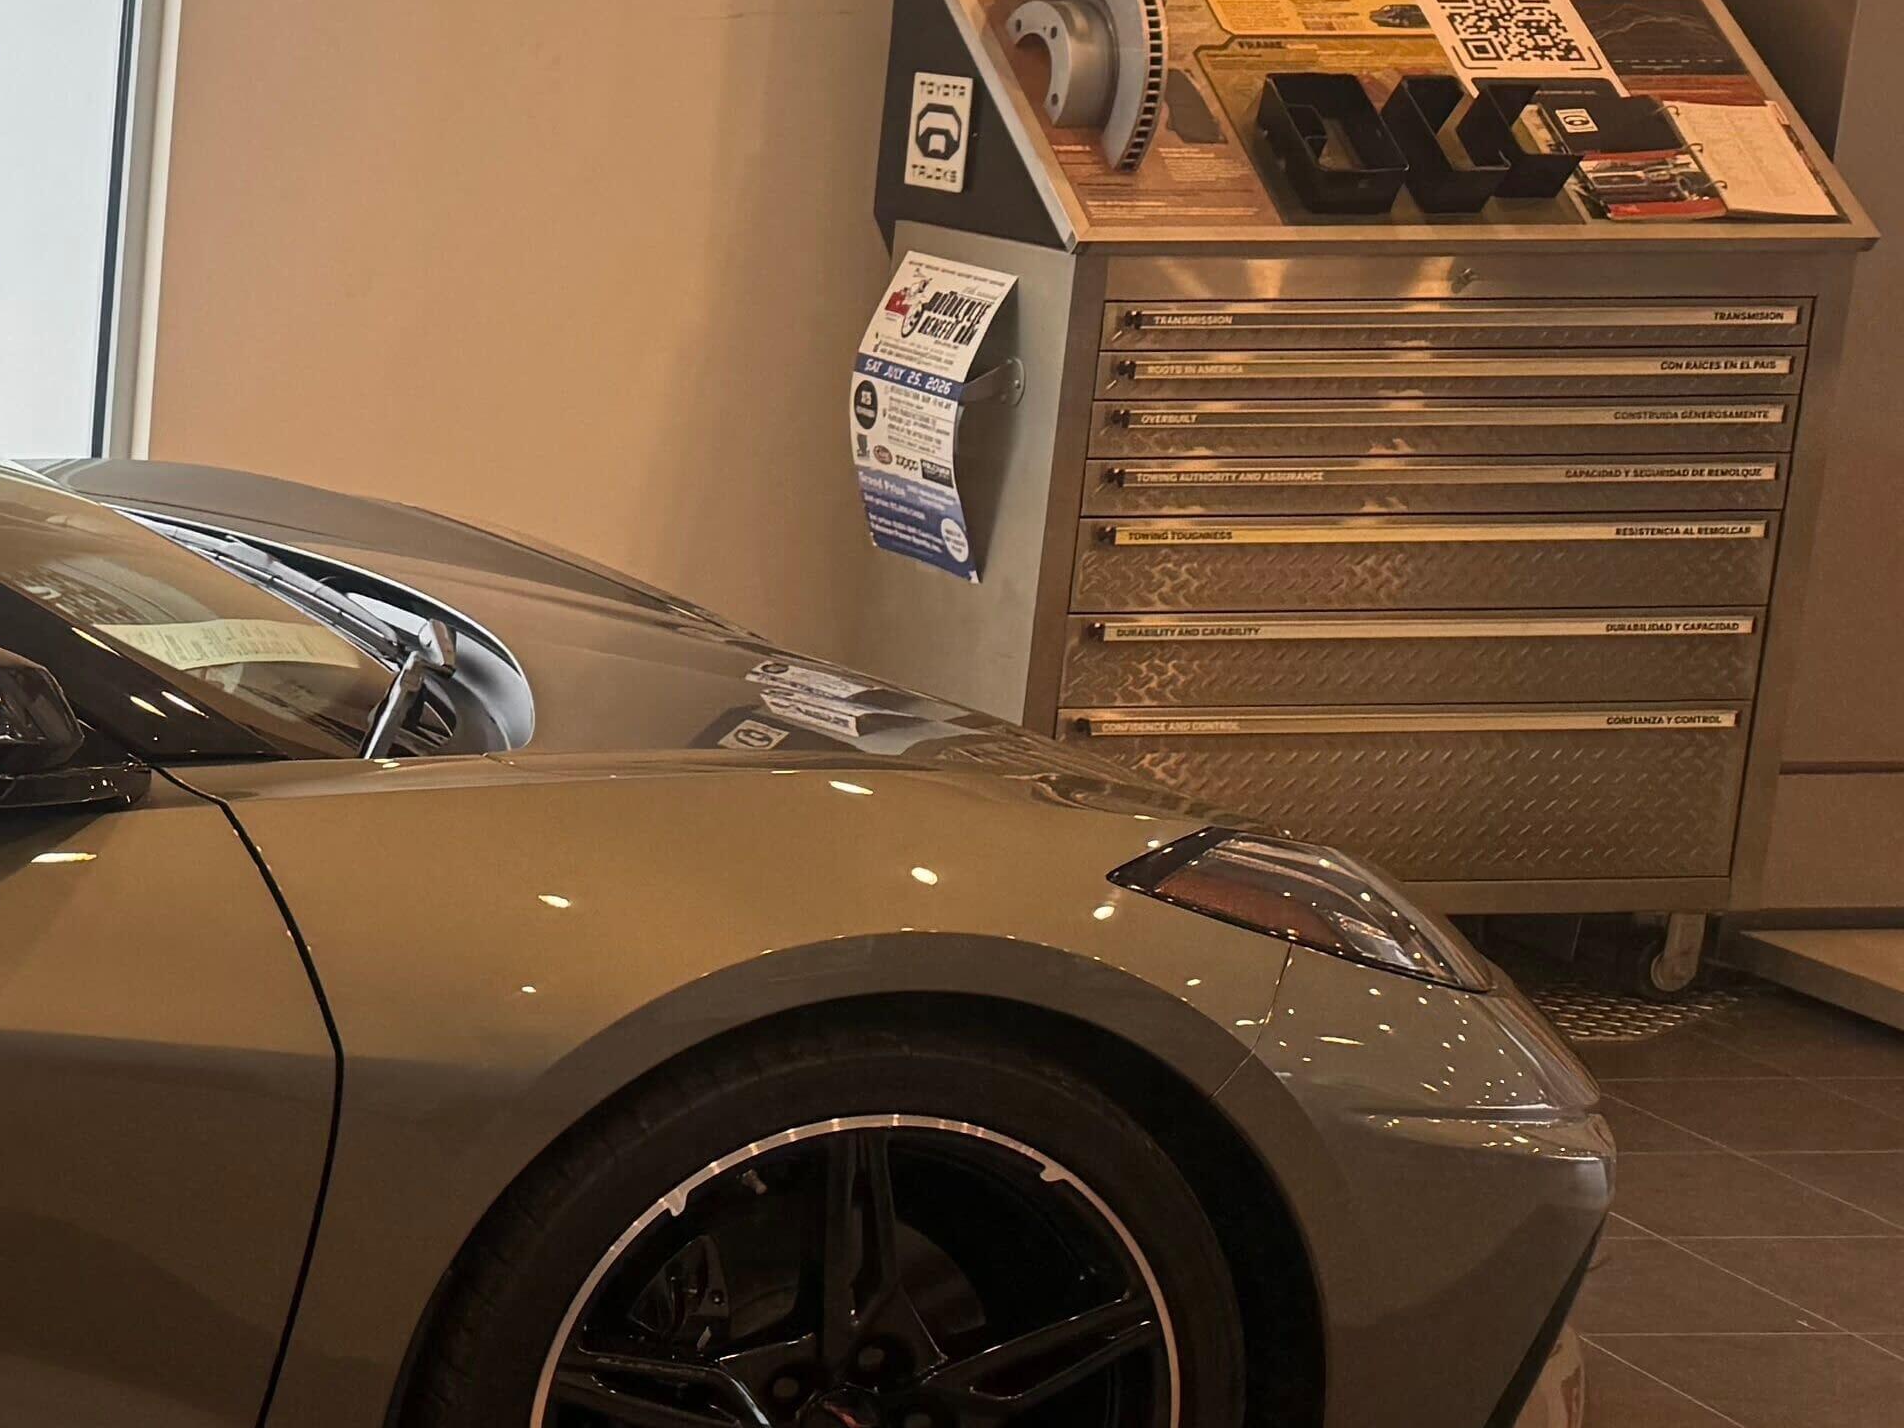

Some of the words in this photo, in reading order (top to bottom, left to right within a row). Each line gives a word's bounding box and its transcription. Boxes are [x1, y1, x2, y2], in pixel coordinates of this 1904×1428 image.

[919, 80, 966, 97] TOYOTA
[1154, 315, 1233, 325] TRANSMISSION
[1146, 365, 1182, 374] ROOTS
[1184, 365, 1196, 374] IN
[1197, 364, 1244, 374] AMERICA
[1660, 361, 1682, 370] CON
[1724, 361, 1738, 369] EN
[1141, 414, 1198, 424] OVERBUILT
[1136, 472, 1177, 482] TOWING
[1179, 472, 1238, 482] AUTHORITY
[1239, 472, 1261, 481] AND
[1263, 471, 1325, 481] ASSURANCE
[1691, 469, 1706, 477] DE
[1708, 468, 1762, 478] REMOLQUE
[1128, 531, 1168, 541] TOWING
[1170, 531, 1233, 540] TOUGHNESS
[1683, 527, 1696, 536] AL
[1116, 628, 1177, 638] DURABILITY
[1177, 628, 1200, 637] AND
[1201, 627, 1260, 637] CAPABILITY
[1674, 715, 1722, 724] CONTROL
[1101, 722, 1165, 733] CONFIDENCE
[1166, 722, 1191, 732] AND
[1192, 721, 1241, 732] CONTROL
